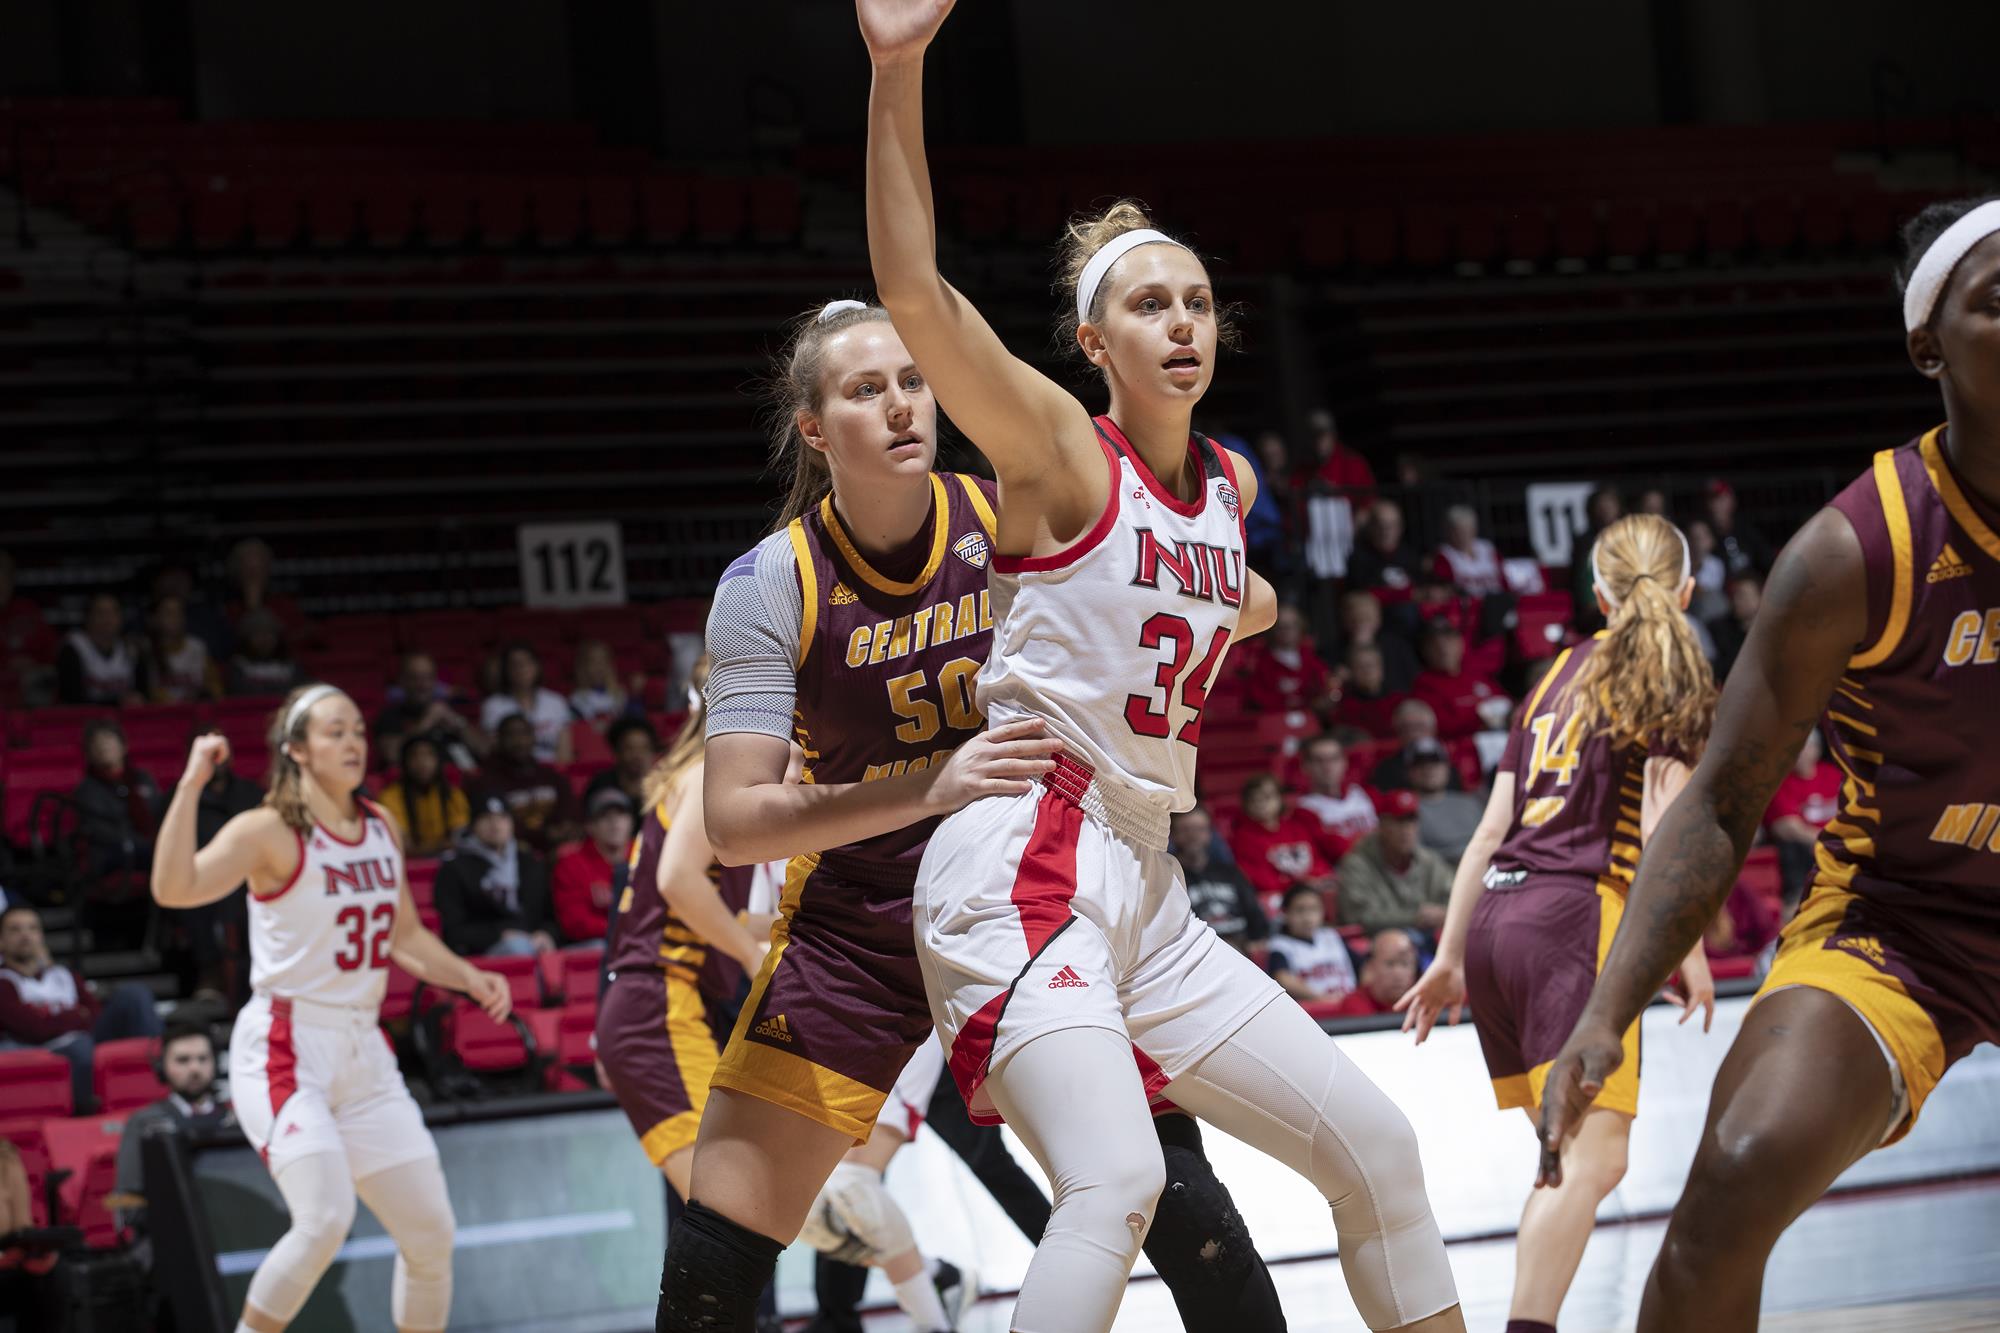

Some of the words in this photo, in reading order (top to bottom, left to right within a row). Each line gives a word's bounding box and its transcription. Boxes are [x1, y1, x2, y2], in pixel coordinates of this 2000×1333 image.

[531, 539, 614, 594] 112
[959, 541, 988, 560] MAC
[1128, 526, 1241, 610] NIU
[845, 589, 994, 668] CENTRAL
[886, 656, 986, 743] 50
[1123, 612, 1232, 748] 34
[1525, 706, 1580, 793] 14
[322, 857, 397, 896] NIU
[335, 902, 396, 972] 32
[1048, 979, 1090, 989] adidas
[754, 1025, 792, 1043] adidas
